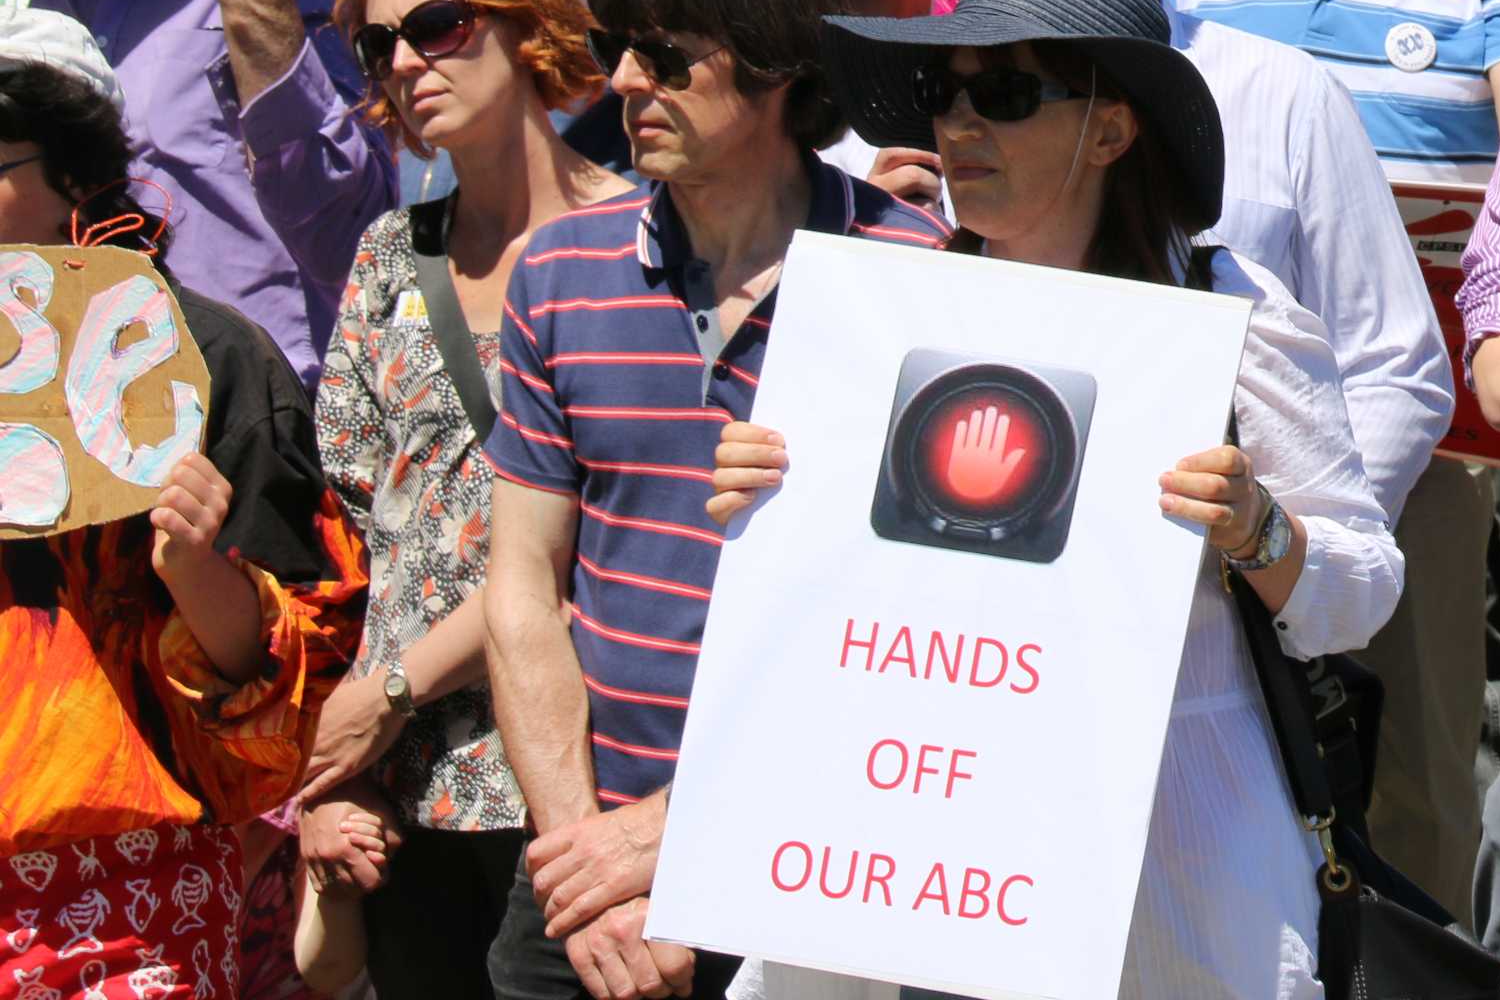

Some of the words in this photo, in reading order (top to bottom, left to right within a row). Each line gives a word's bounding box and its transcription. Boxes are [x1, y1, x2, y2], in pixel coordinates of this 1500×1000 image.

[839, 618, 1043, 695] HANDS
[866, 738, 977, 799] OFF
[770, 840, 897, 906] OUR
[912, 861, 1035, 926] ABC
